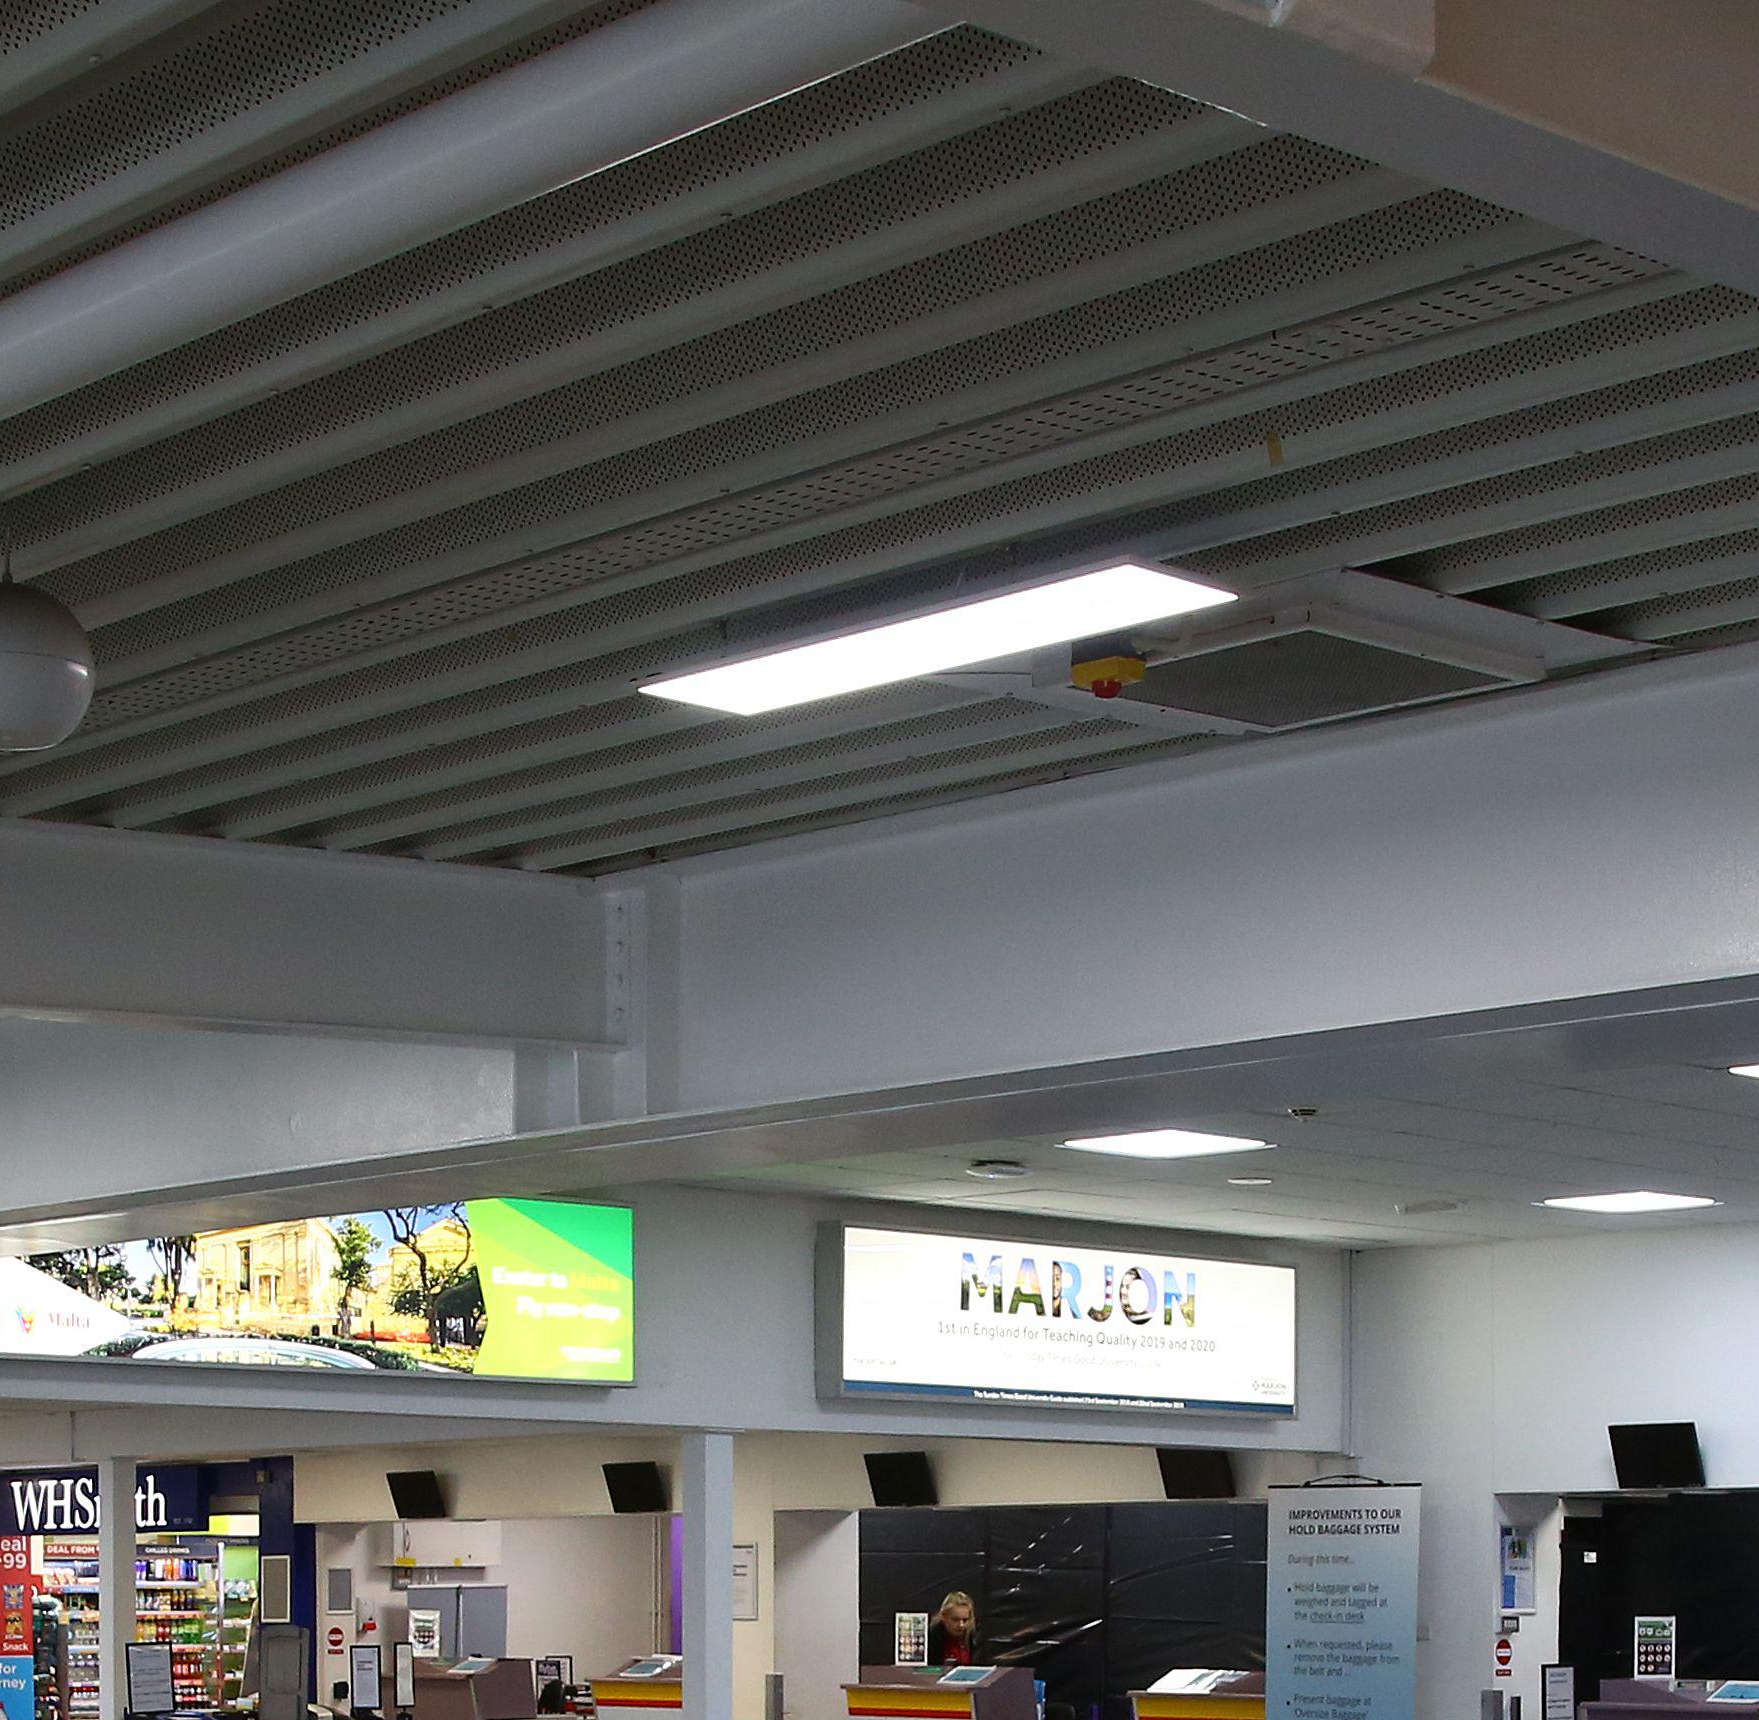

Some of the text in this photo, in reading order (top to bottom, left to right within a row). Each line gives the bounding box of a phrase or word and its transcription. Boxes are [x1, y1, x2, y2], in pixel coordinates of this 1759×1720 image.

[959, 1251, 1197, 1328] MARJON
[938, 1320, 1216, 1353] 1st in England for Teaching Quality 2019 and 2020
[10, 1474, 168, 1532] WHSth
[1289, 1508, 1402, 1520] IMPROVEMENTS TO OUR
[1288, 1523, 1400, 1536] HOLD BAGGAGE SYSTEM
[46, 1545, 96, 1555] DEAL FROM
[2, 1642, 29, 1652] Snack
